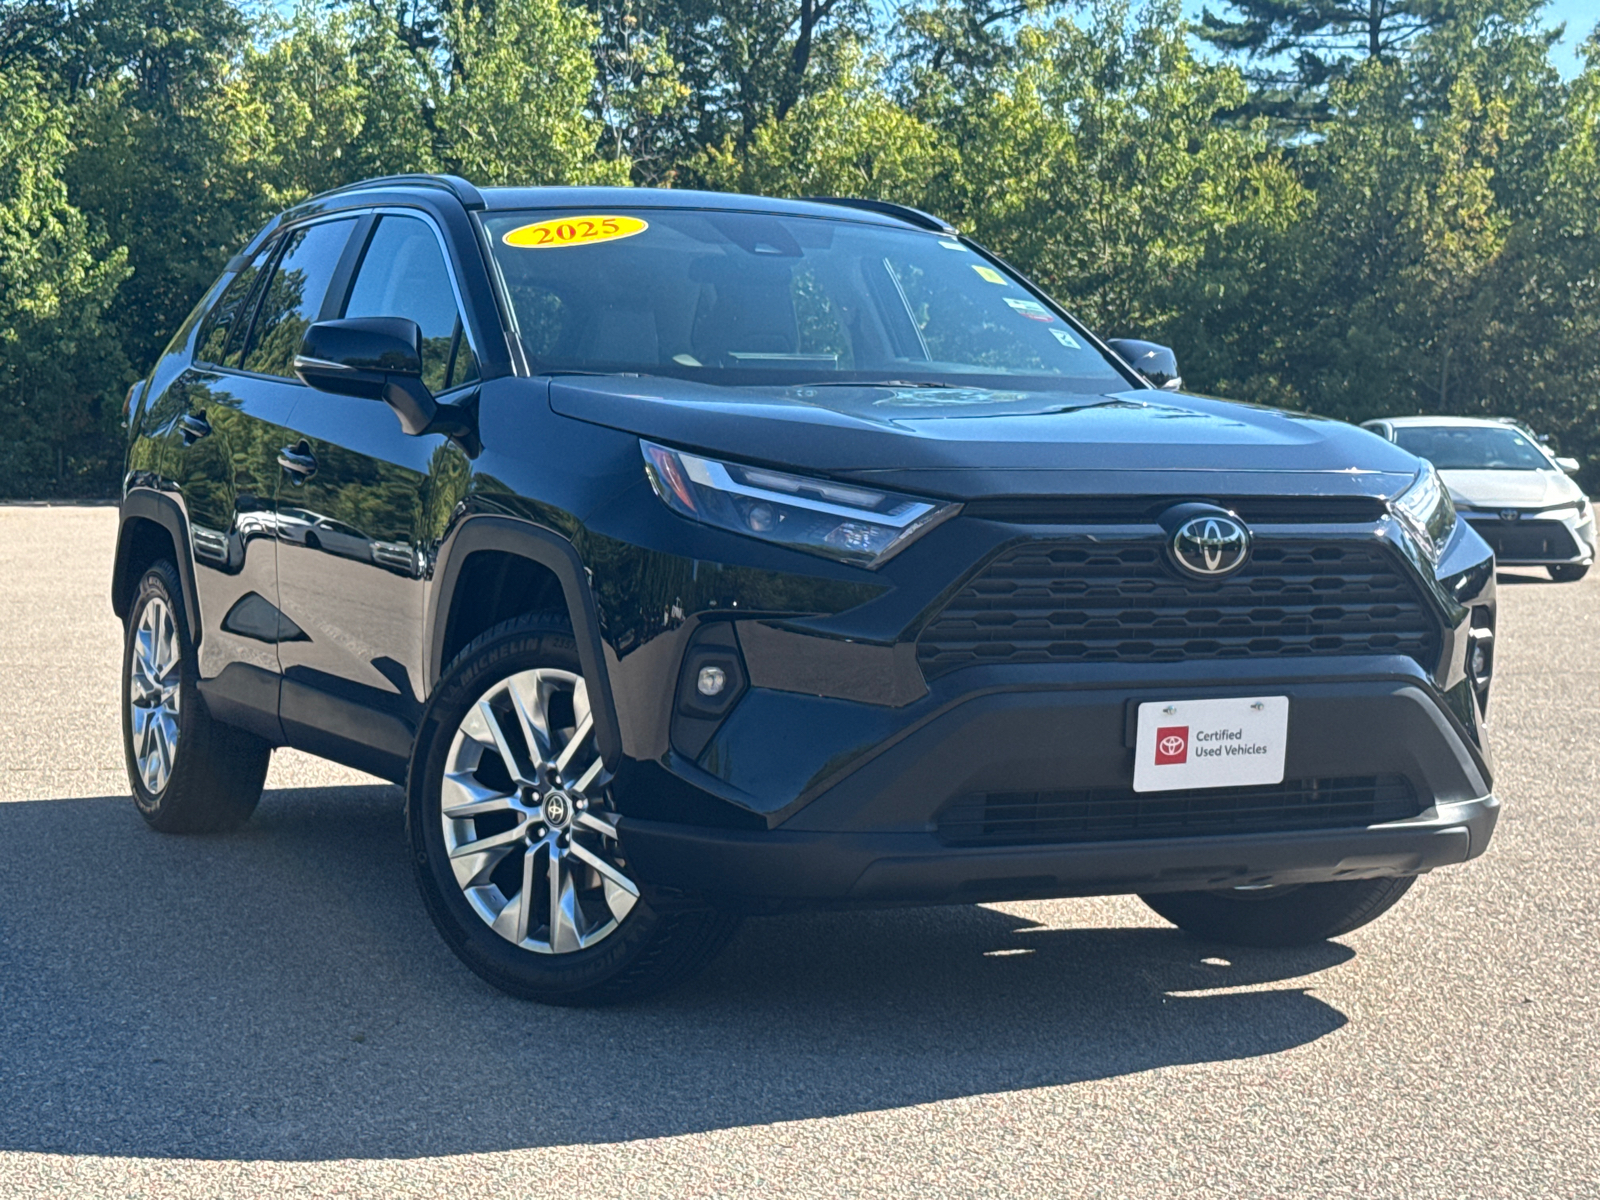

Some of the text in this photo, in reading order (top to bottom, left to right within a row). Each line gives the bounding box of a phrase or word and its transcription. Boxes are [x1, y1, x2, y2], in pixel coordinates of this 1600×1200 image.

[532, 218, 620, 245] 2025
[459, 637, 539, 687] MICHELIN
[1196, 728, 1242, 742] Certified
[1195, 743, 1267, 757] Used Vehicles
